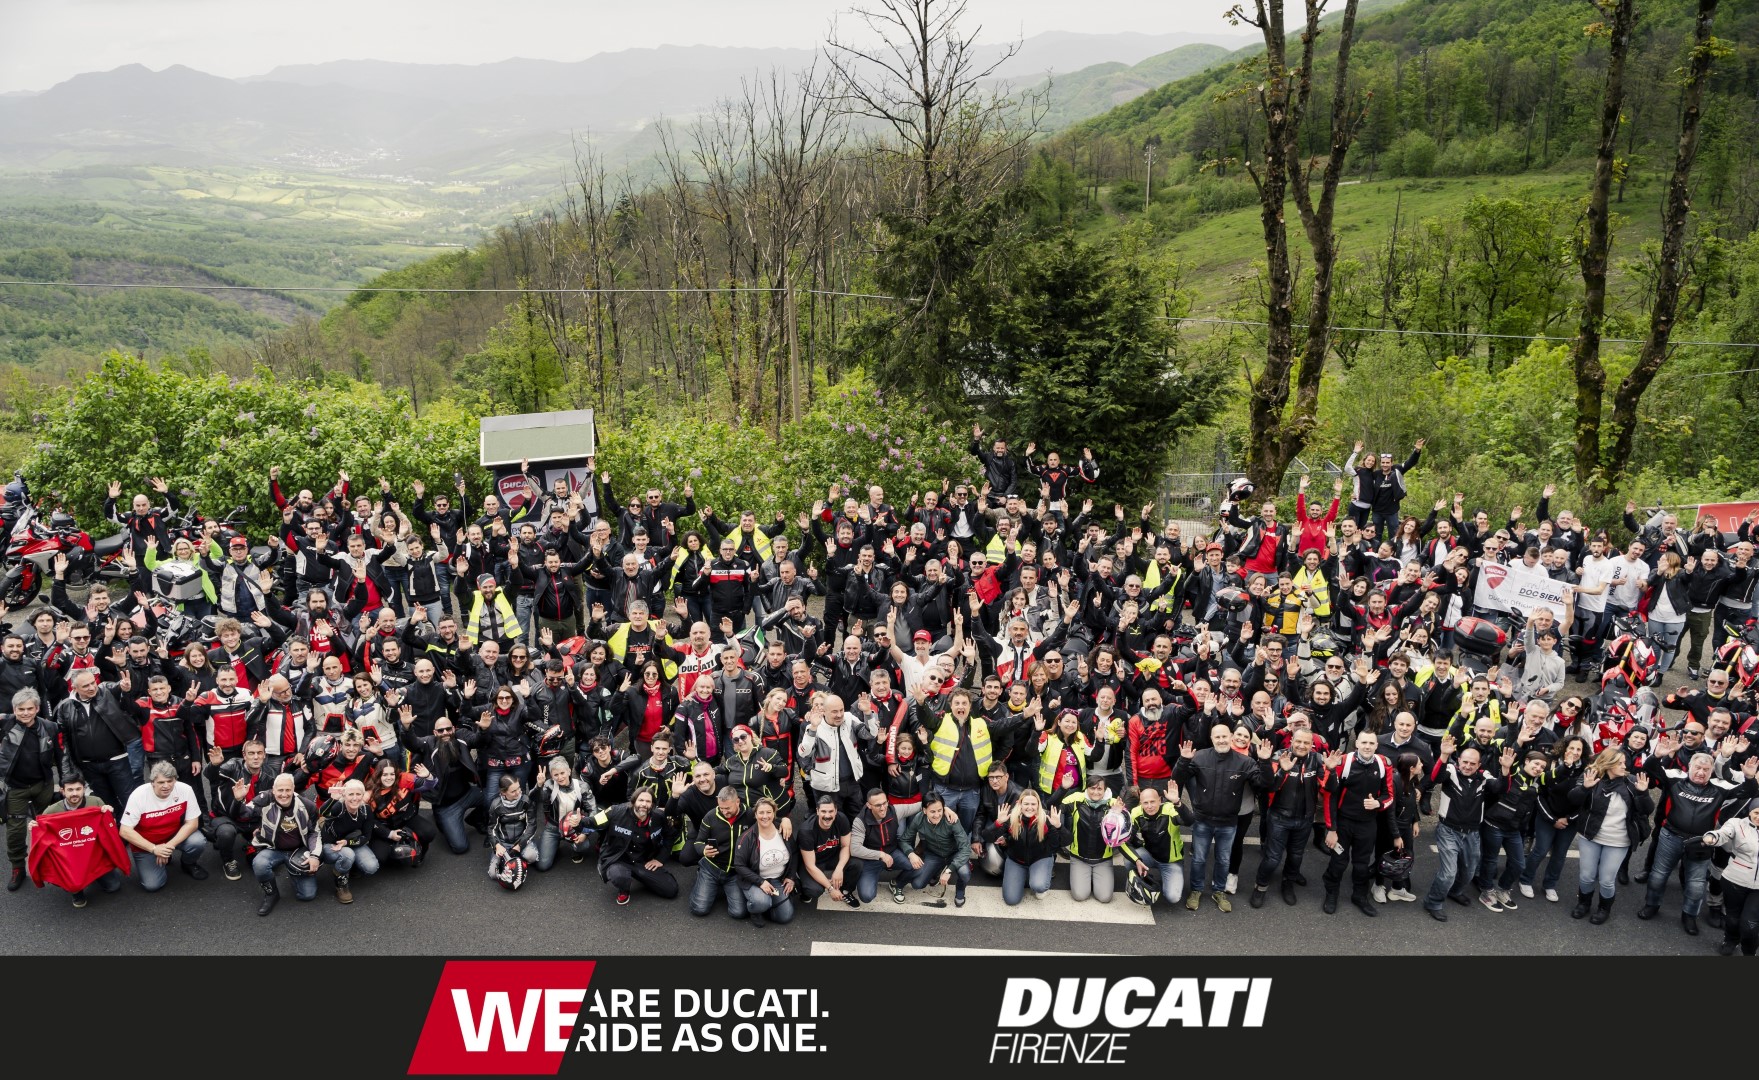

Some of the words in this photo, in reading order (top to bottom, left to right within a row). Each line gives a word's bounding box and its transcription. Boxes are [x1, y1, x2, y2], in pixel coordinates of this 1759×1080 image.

[1519, 587, 1539, 597] DOC
[681, 660, 715, 673] DUCATI
[888, 726, 897, 755] DUCATI
[1678, 791, 1714, 803] DAINESE
[146, 811, 166, 819] DUCATI
